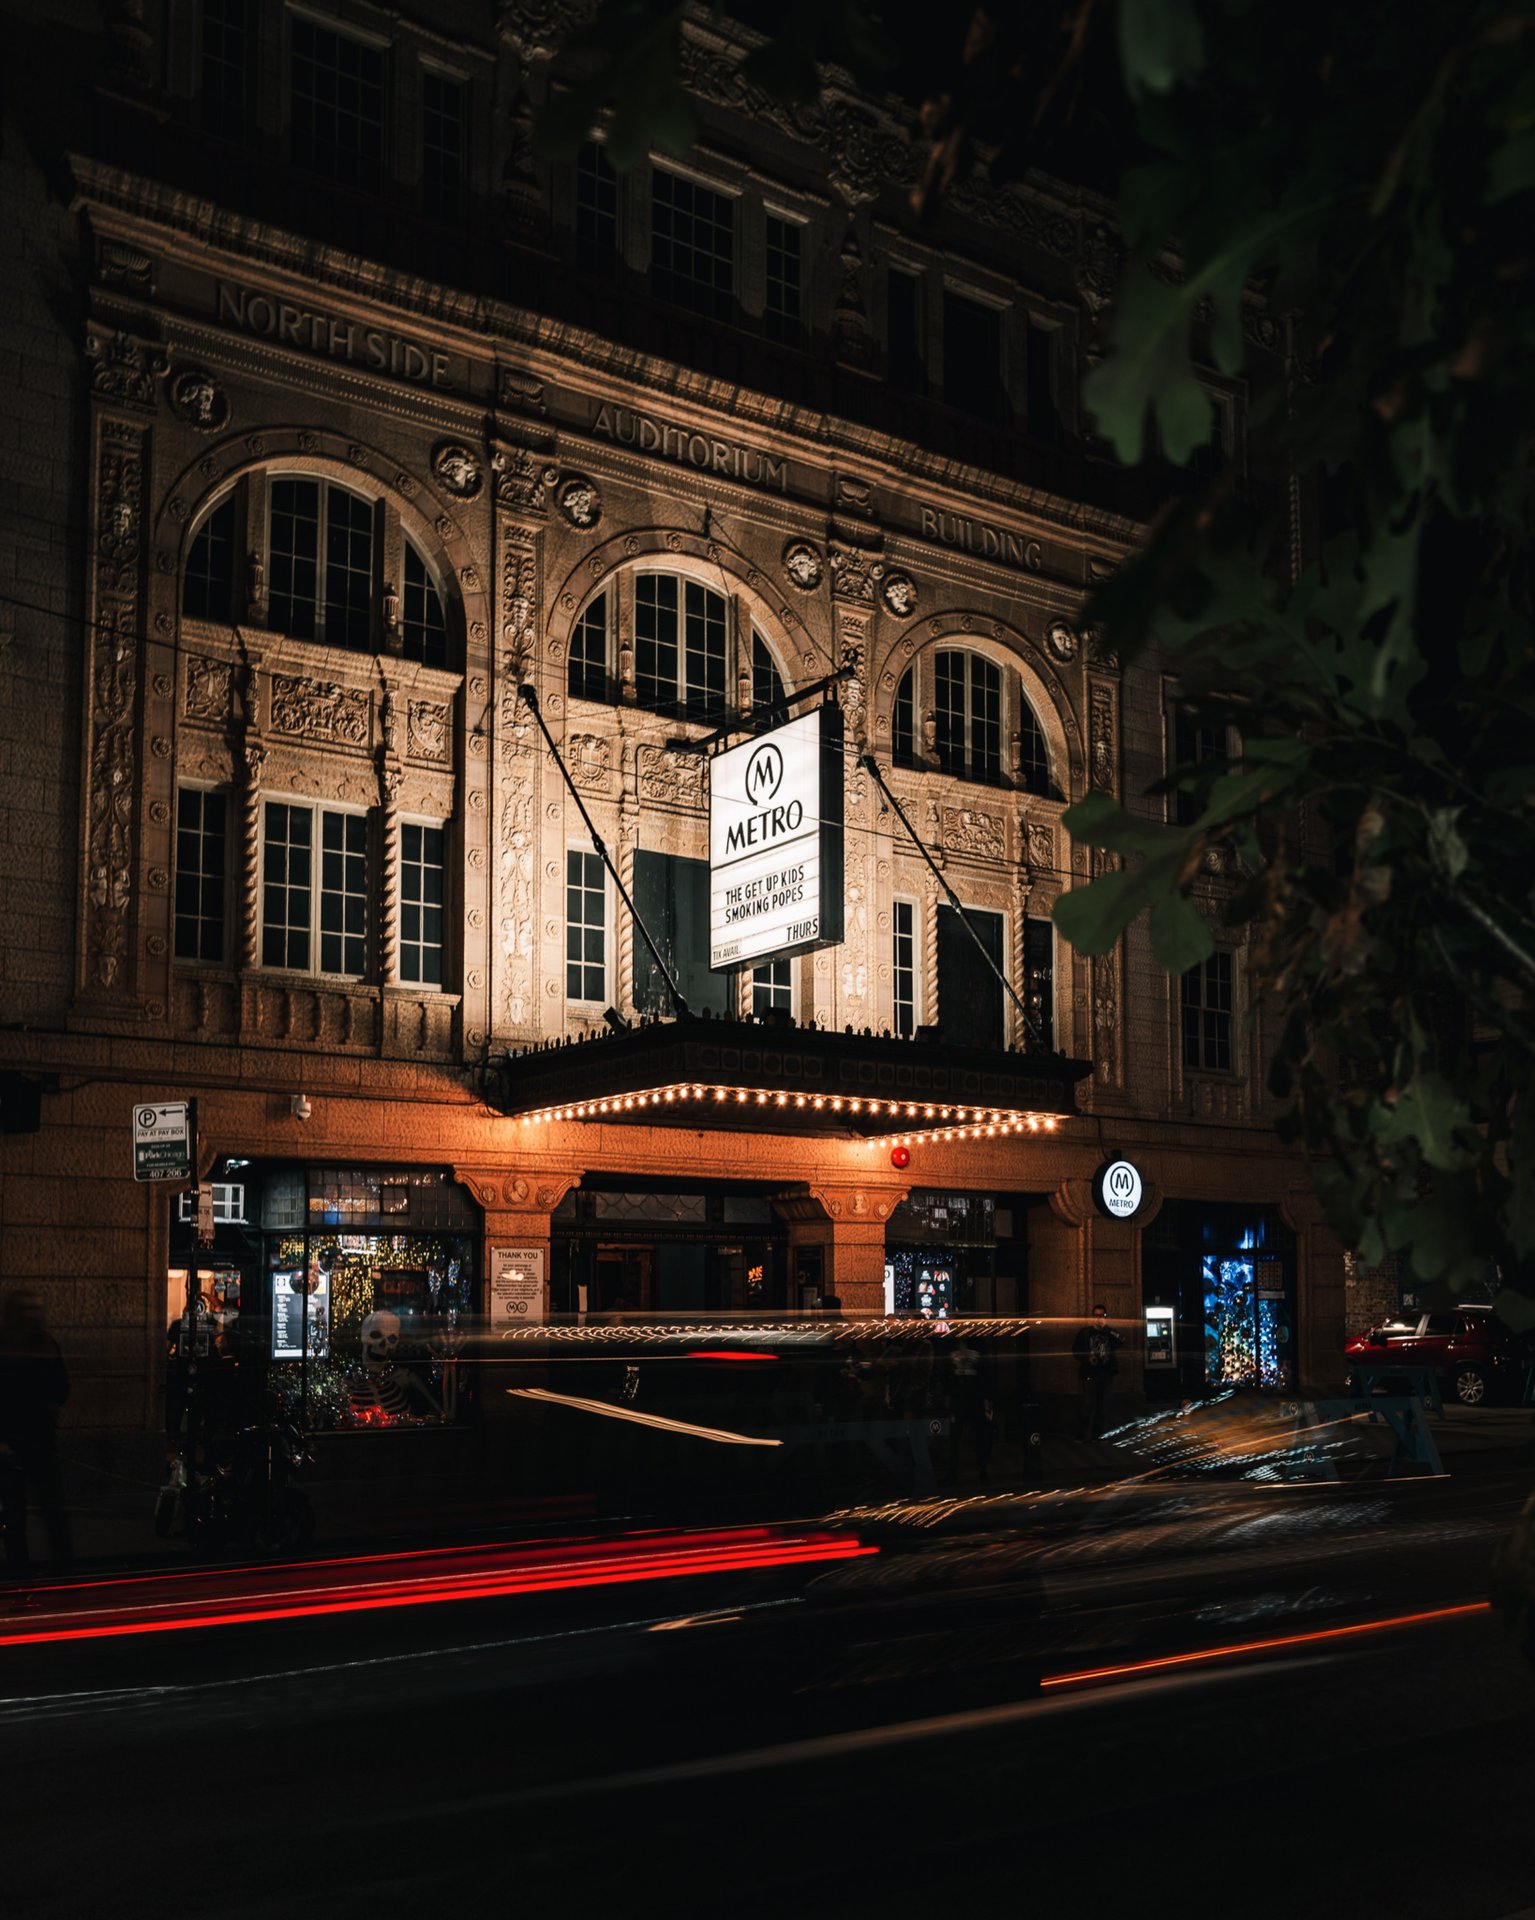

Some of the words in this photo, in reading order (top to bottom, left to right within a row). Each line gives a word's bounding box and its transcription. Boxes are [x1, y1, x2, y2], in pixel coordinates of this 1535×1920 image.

[217, 284, 354, 361] NORTH
[364, 330, 454, 390] SIDE
[592, 403, 789, 493] AUDITORIUM
[920, 506, 1041, 570] BUILDING
[725, 799, 803, 855] METRO
[726, 887, 742, 905] THE
[745, 880, 763, 900] GET
[766, 874, 779, 892] UP
[781, 865, 804, 888] KIDS
[726, 896, 769, 924] SMOKING
[772, 884, 803, 910] POPES
[787, 917, 818, 942] THURS
[138, 1129, 148, 1138] PAY
[150, 1128, 158, 1137] AT
[158, 1128, 169, 1136] PAY
[171, 1126, 184, 1135] BOX
[143, 1112, 153, 1125] P
[150, 1169, 165, 1178] 407
[167, 1168, 182, 1178] 206
[1109, 1198, 1134, 1209] METRO
[498, 1251, 521, 1259] THANK
[523, 1252, 538, 1260] YOU
